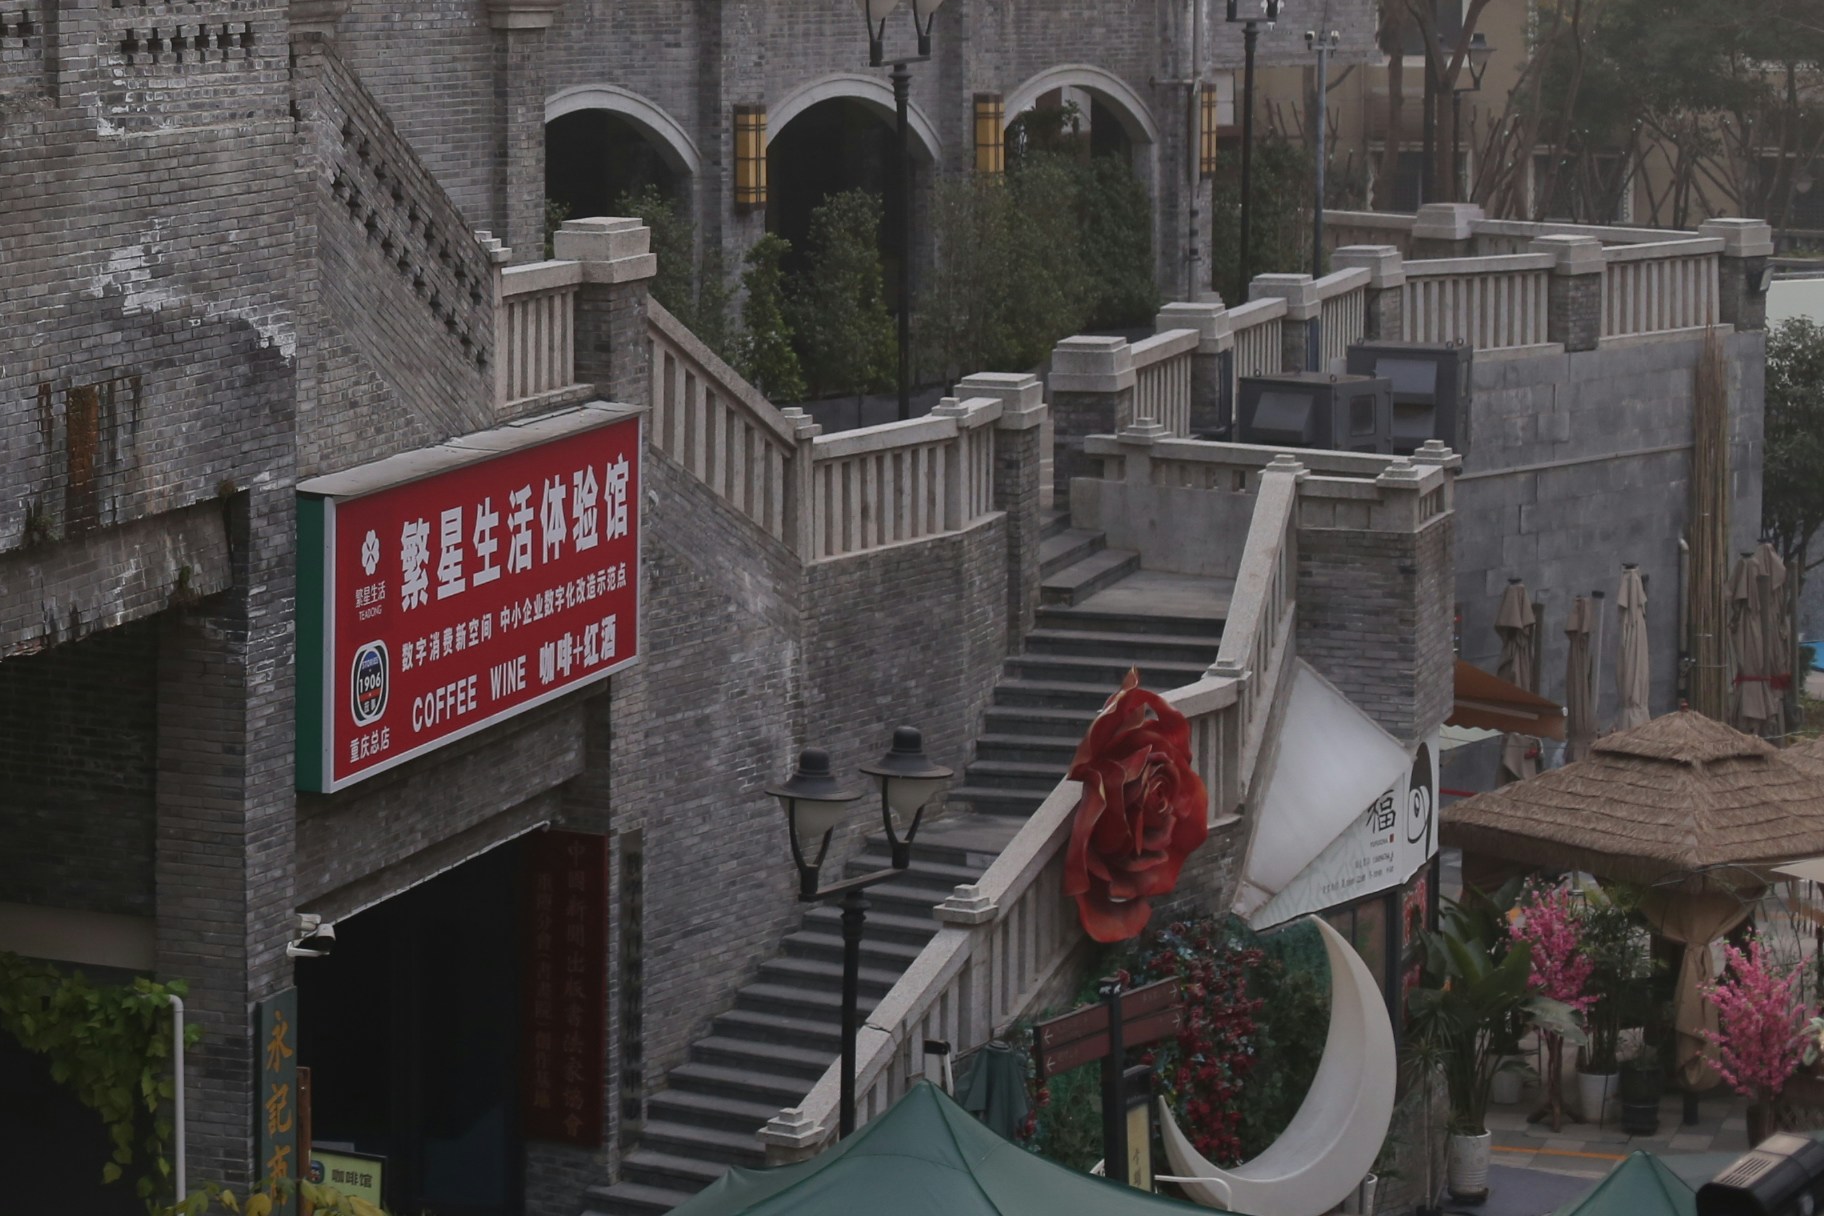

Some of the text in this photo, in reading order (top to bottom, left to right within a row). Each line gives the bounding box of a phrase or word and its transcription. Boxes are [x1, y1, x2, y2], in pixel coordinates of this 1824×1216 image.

[400, 453, 630, 612] 繁星生活体验馆
[355, 580, 386, 610] 繁星生活
[402, 561, 627, 673] 数字消费新空间 中小企业数字化改造示范点
[539, 613, 617, 685] 咖啡+红酒
[359, 671, 382, 694] 1906
[412, 655, 527, 734] COFFEE WINE
[349, 725, 391, 764] 重庆总店
[332, 1167, 374, 1189] 咖啡馆
